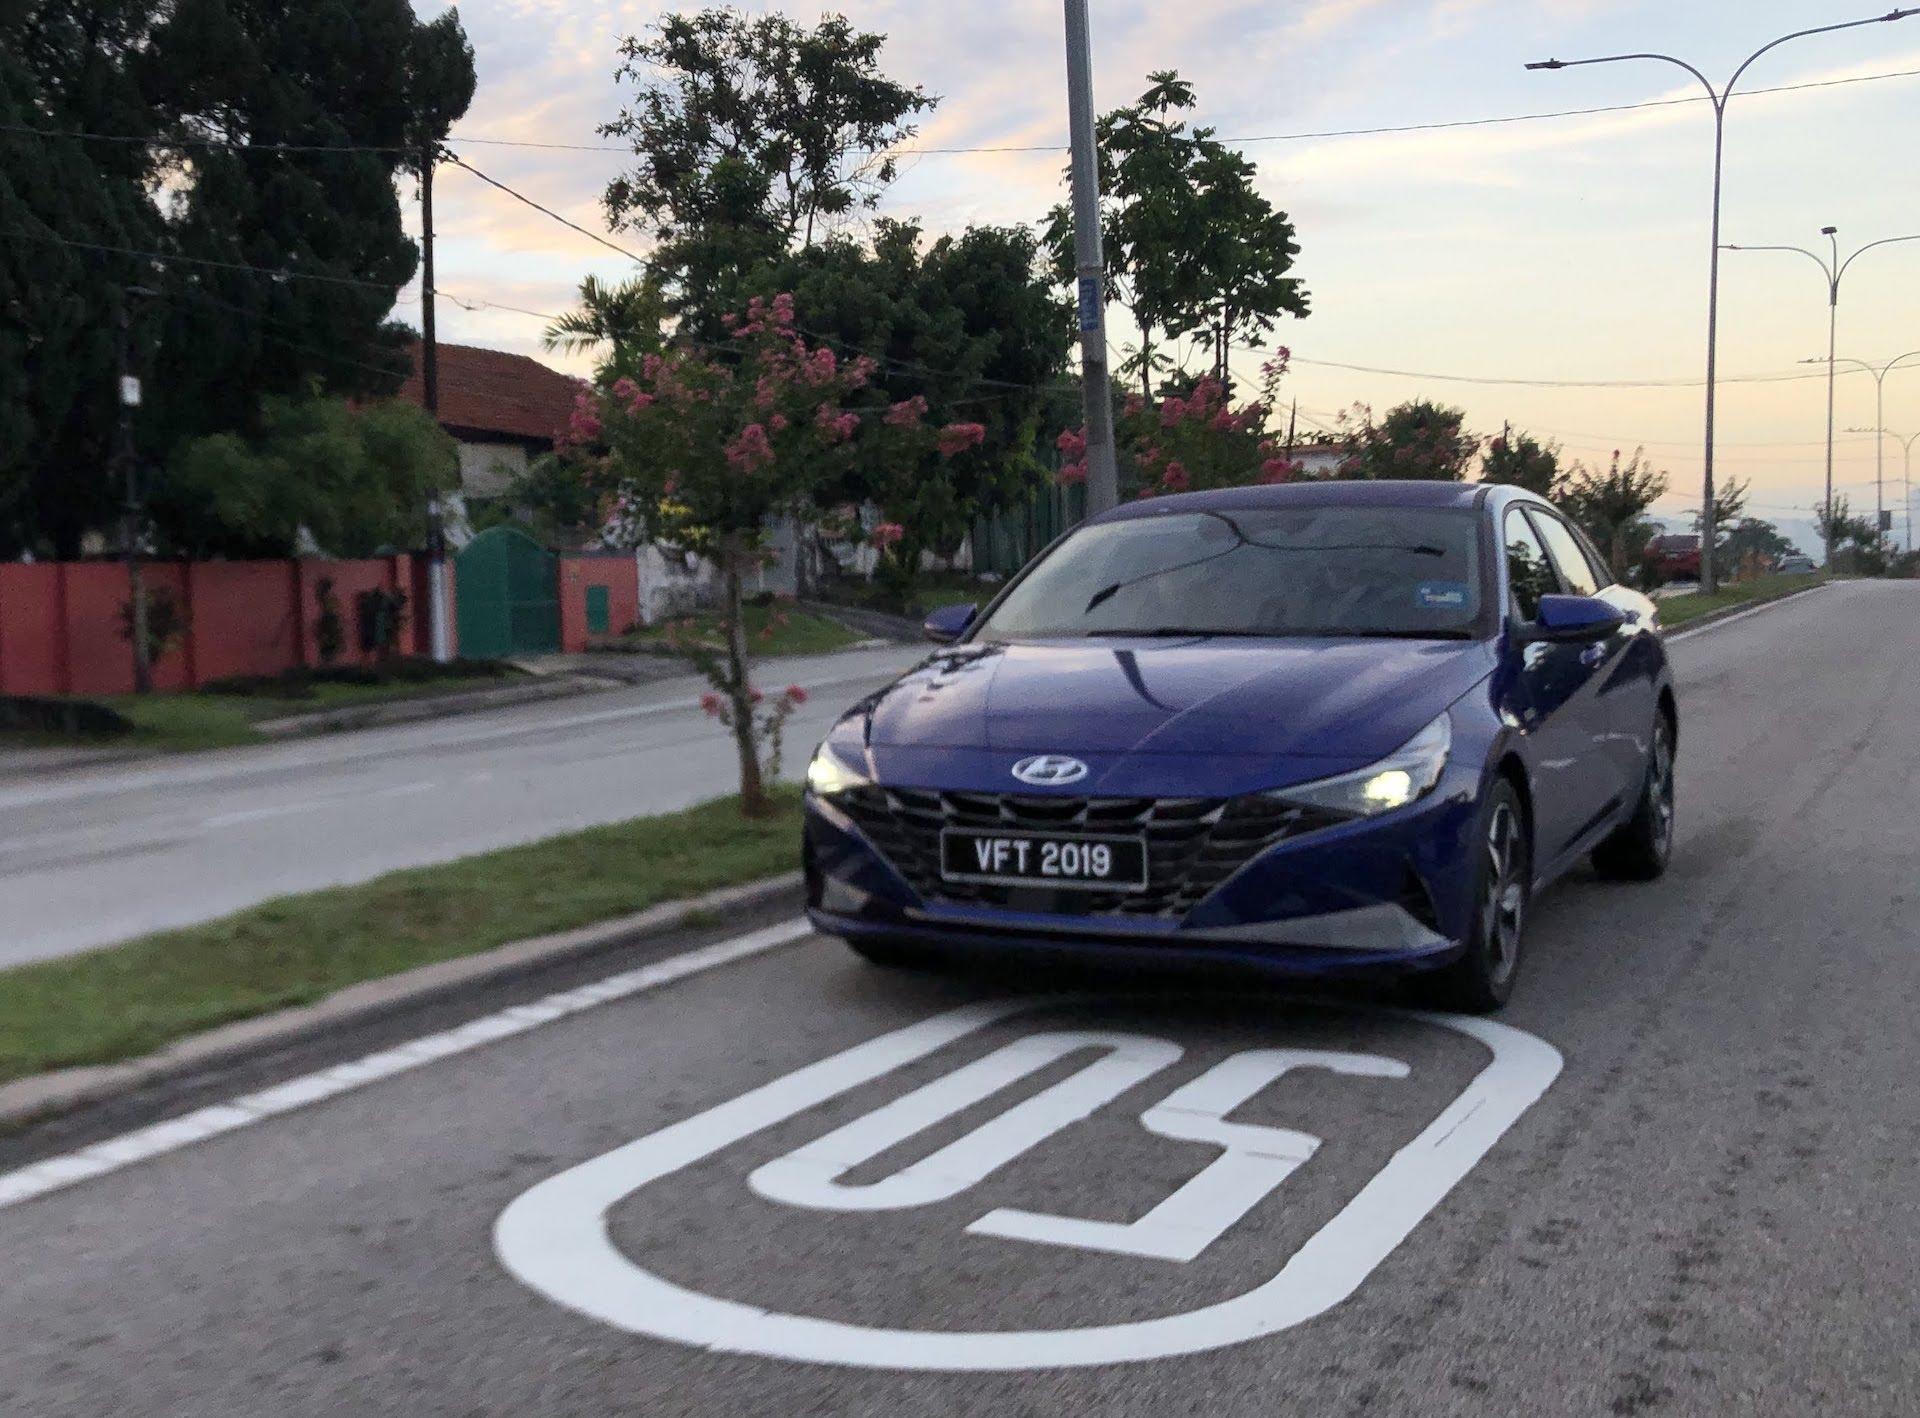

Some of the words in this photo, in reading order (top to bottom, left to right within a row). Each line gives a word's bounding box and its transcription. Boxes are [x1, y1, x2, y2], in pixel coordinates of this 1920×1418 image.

[974, 839, 1030, 873] VFT
[1041, 842, 1111, 877] 2019
[748, 1031, 1410, 1262] 50
